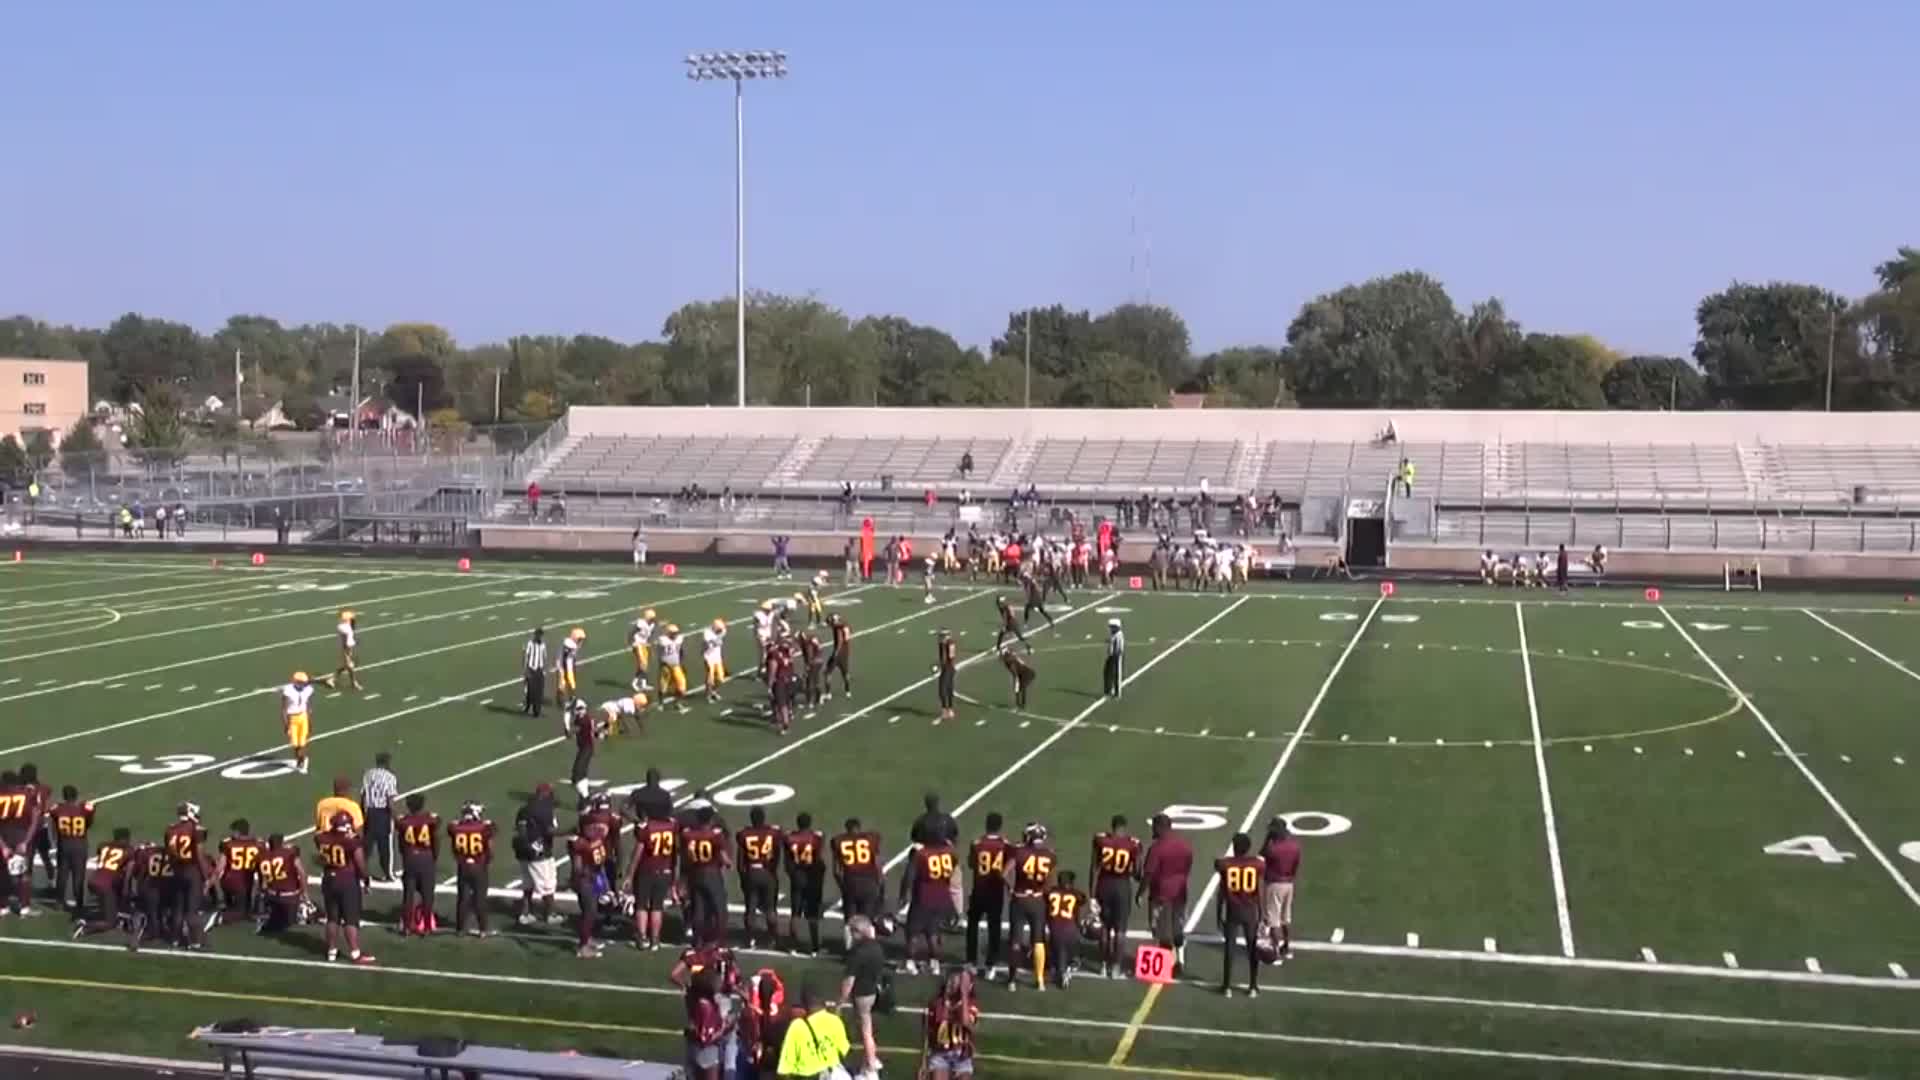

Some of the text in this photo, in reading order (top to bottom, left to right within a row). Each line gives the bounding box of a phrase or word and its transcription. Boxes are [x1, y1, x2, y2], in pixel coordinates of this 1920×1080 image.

[0, 795, 26, 818] 77
[405, 824, 430, 846] 44
[650, 831, 673, 856] 73
[745, 835, 773, 860] 54
[100, 846, 123, 871] 12
[840, 839, 871, 865] 56
[1102, 847, 1130, 873] 20
[1227, 866, 1257, 892] 80
[1049, 892, 1076, 919] 33
[1141, 950, 1163, 976] 50
